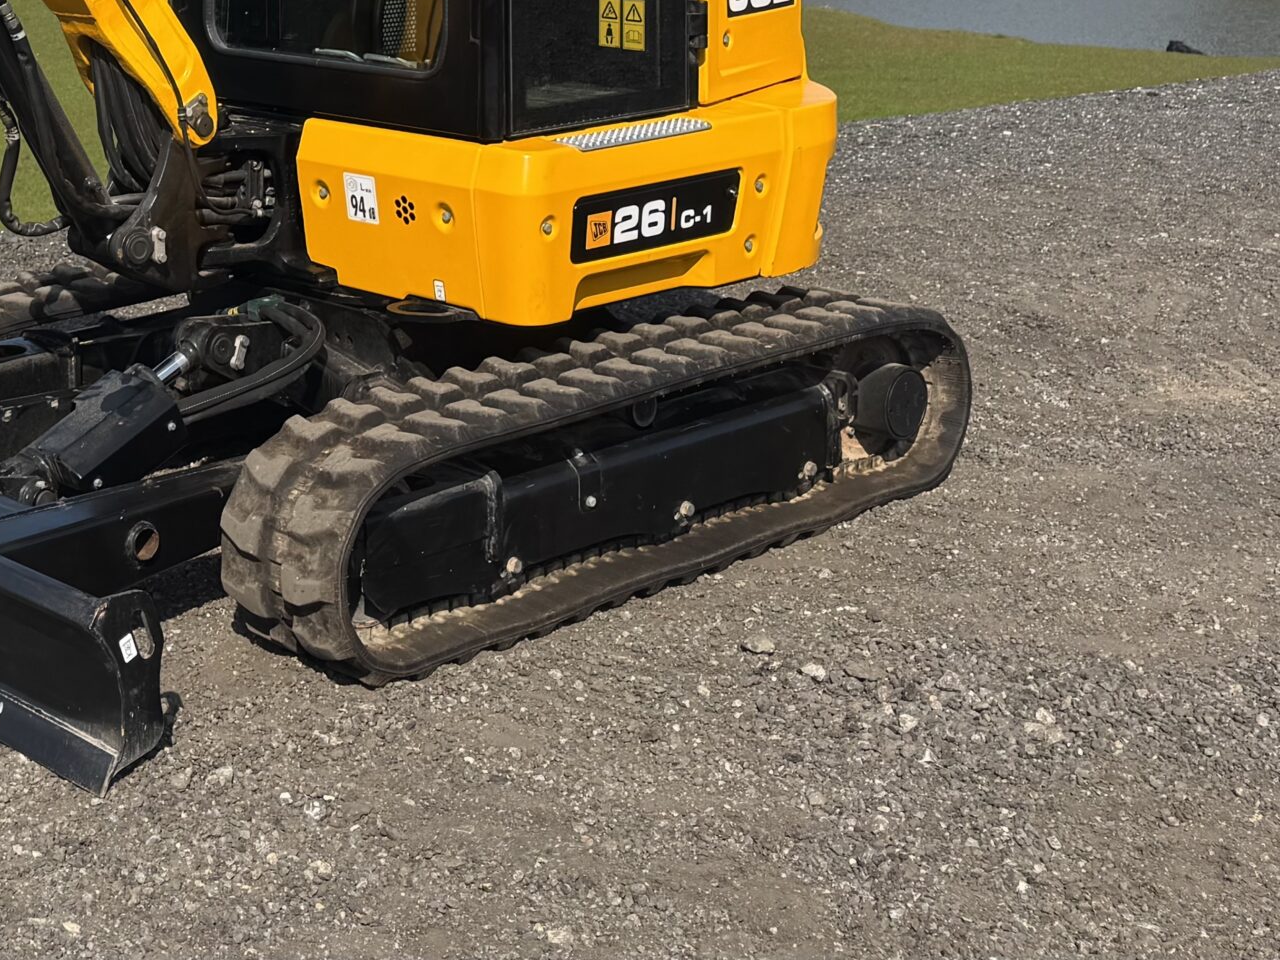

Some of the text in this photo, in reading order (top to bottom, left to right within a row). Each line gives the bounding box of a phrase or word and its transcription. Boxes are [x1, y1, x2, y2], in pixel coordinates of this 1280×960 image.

[350, 194, 366, 218] 94
[593, 221, 608, 239] JCB
[613, 199, 666, 245] 26
